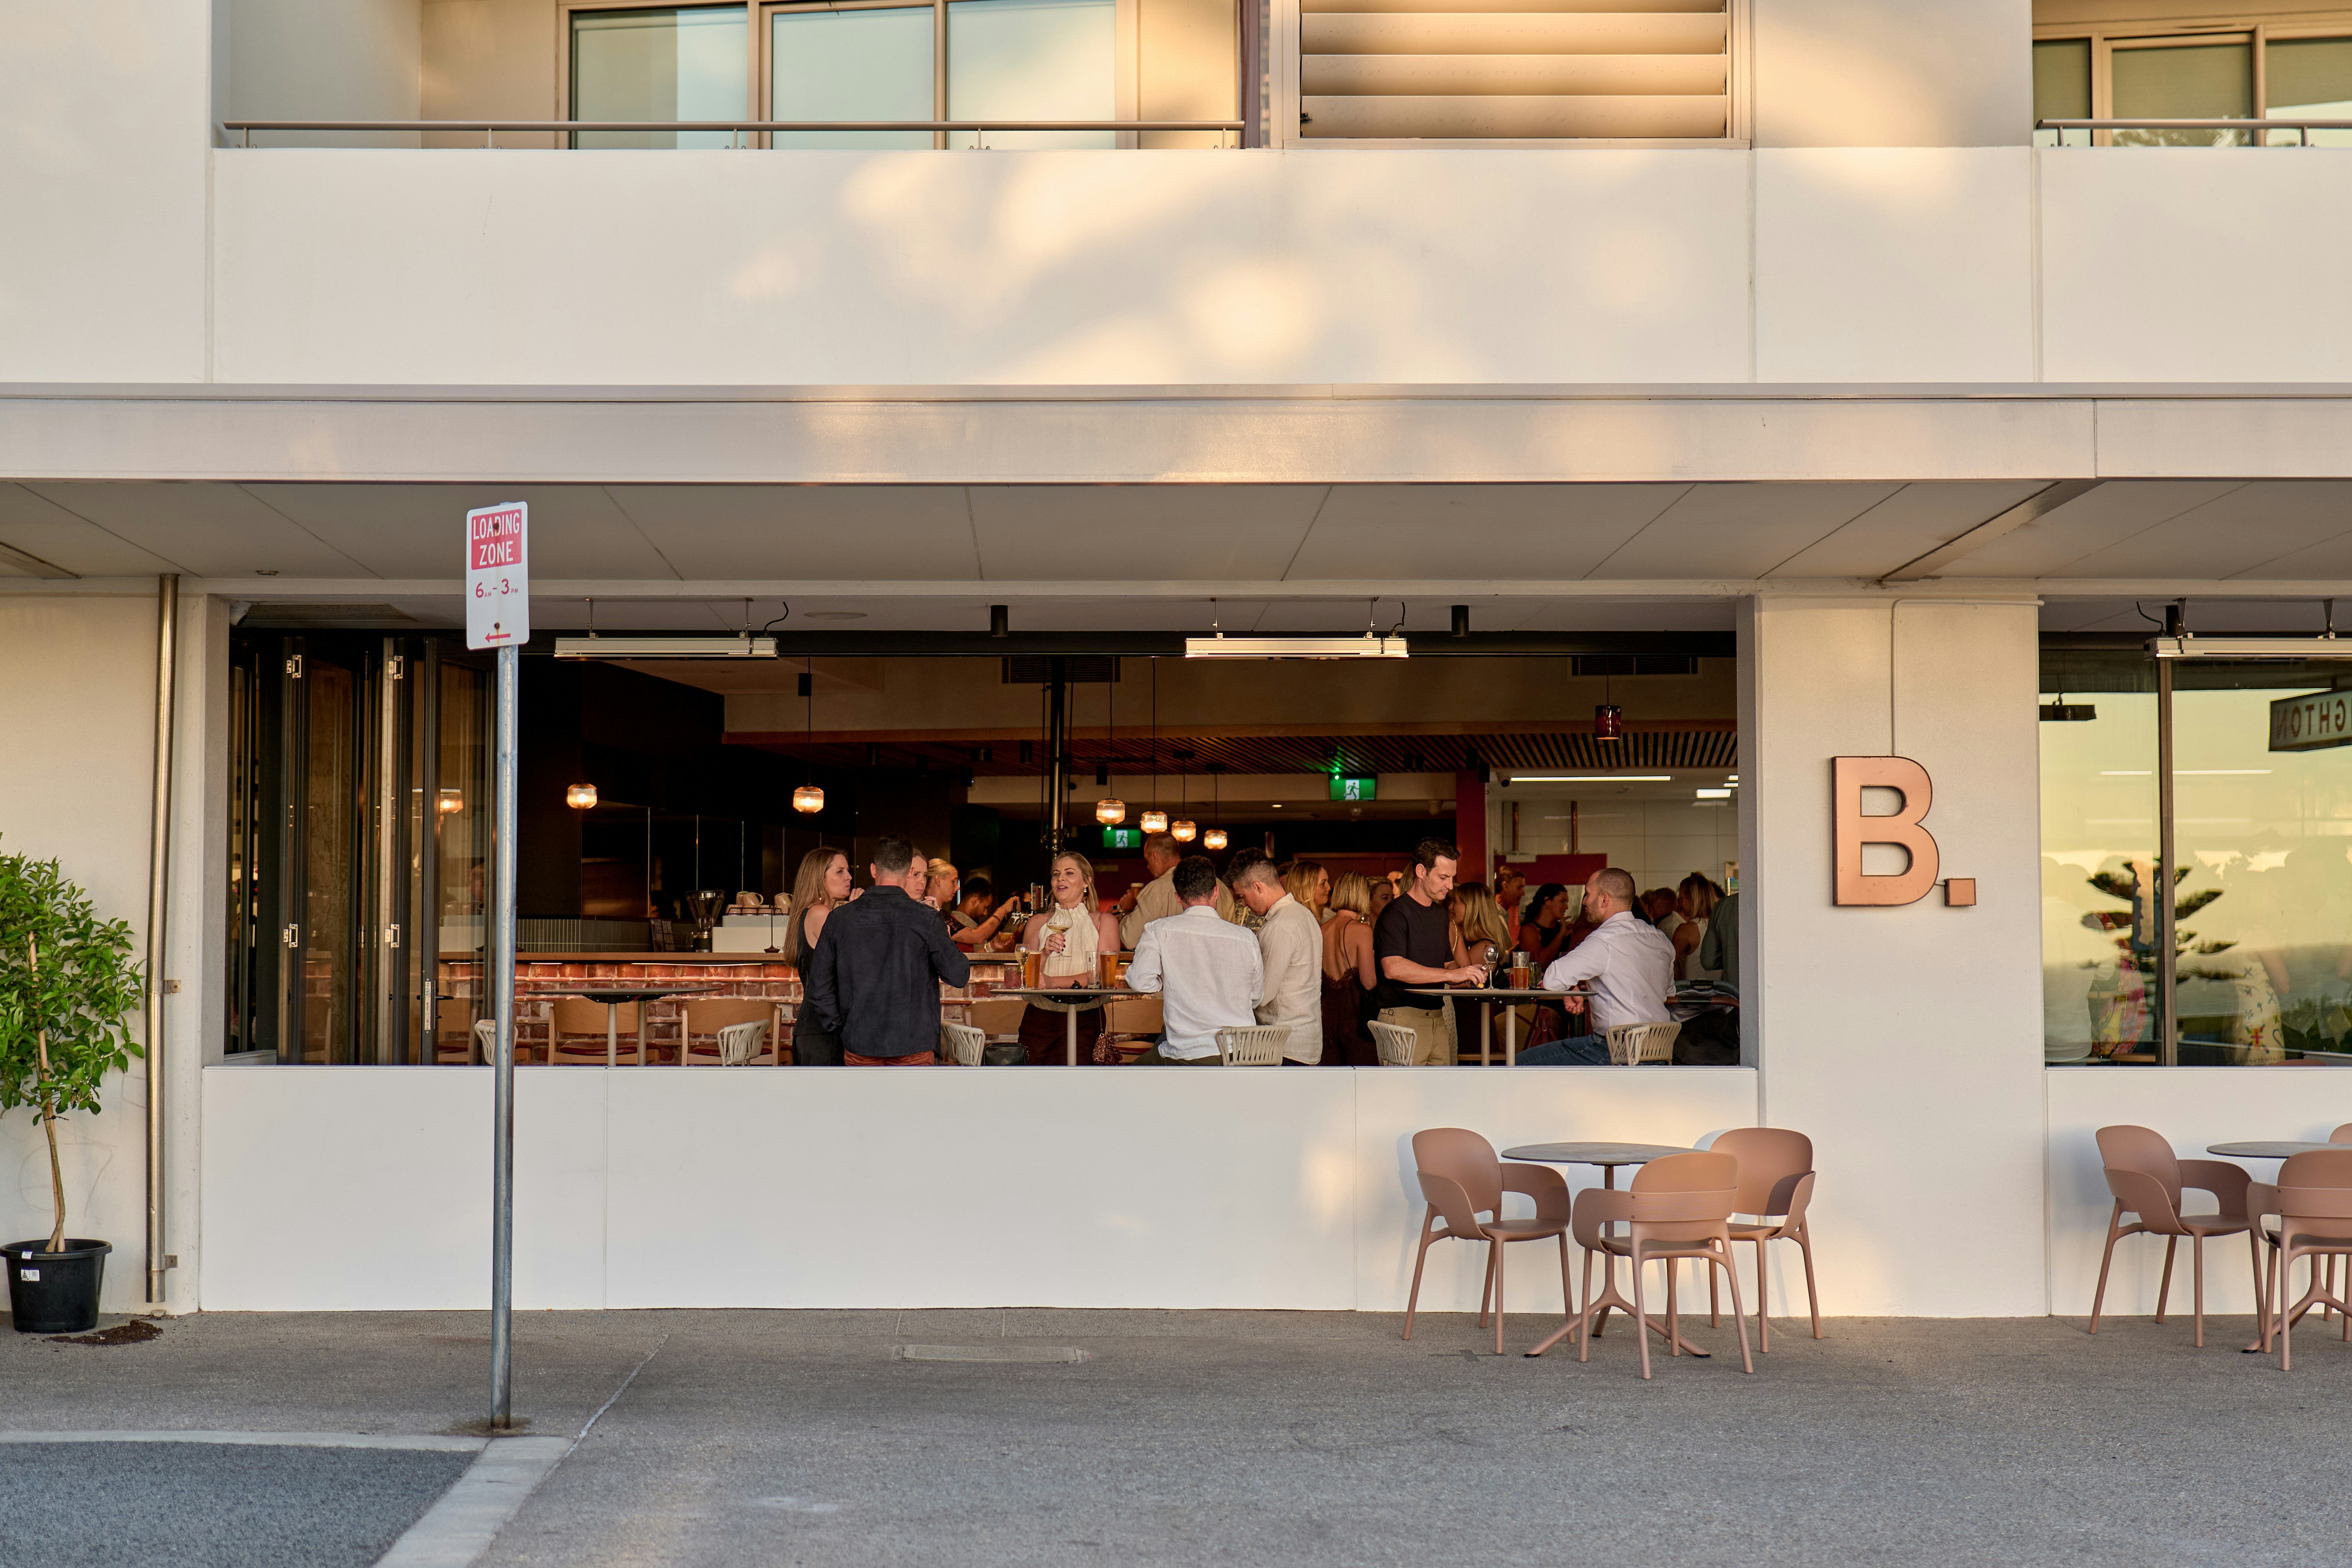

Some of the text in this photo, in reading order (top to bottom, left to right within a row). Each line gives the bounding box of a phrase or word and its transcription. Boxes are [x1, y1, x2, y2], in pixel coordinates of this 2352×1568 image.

[473, 512, 520, 540] LOADING
[479, 541, 514, 565] ZONE
[1832, 756, 1977, 907] B.
